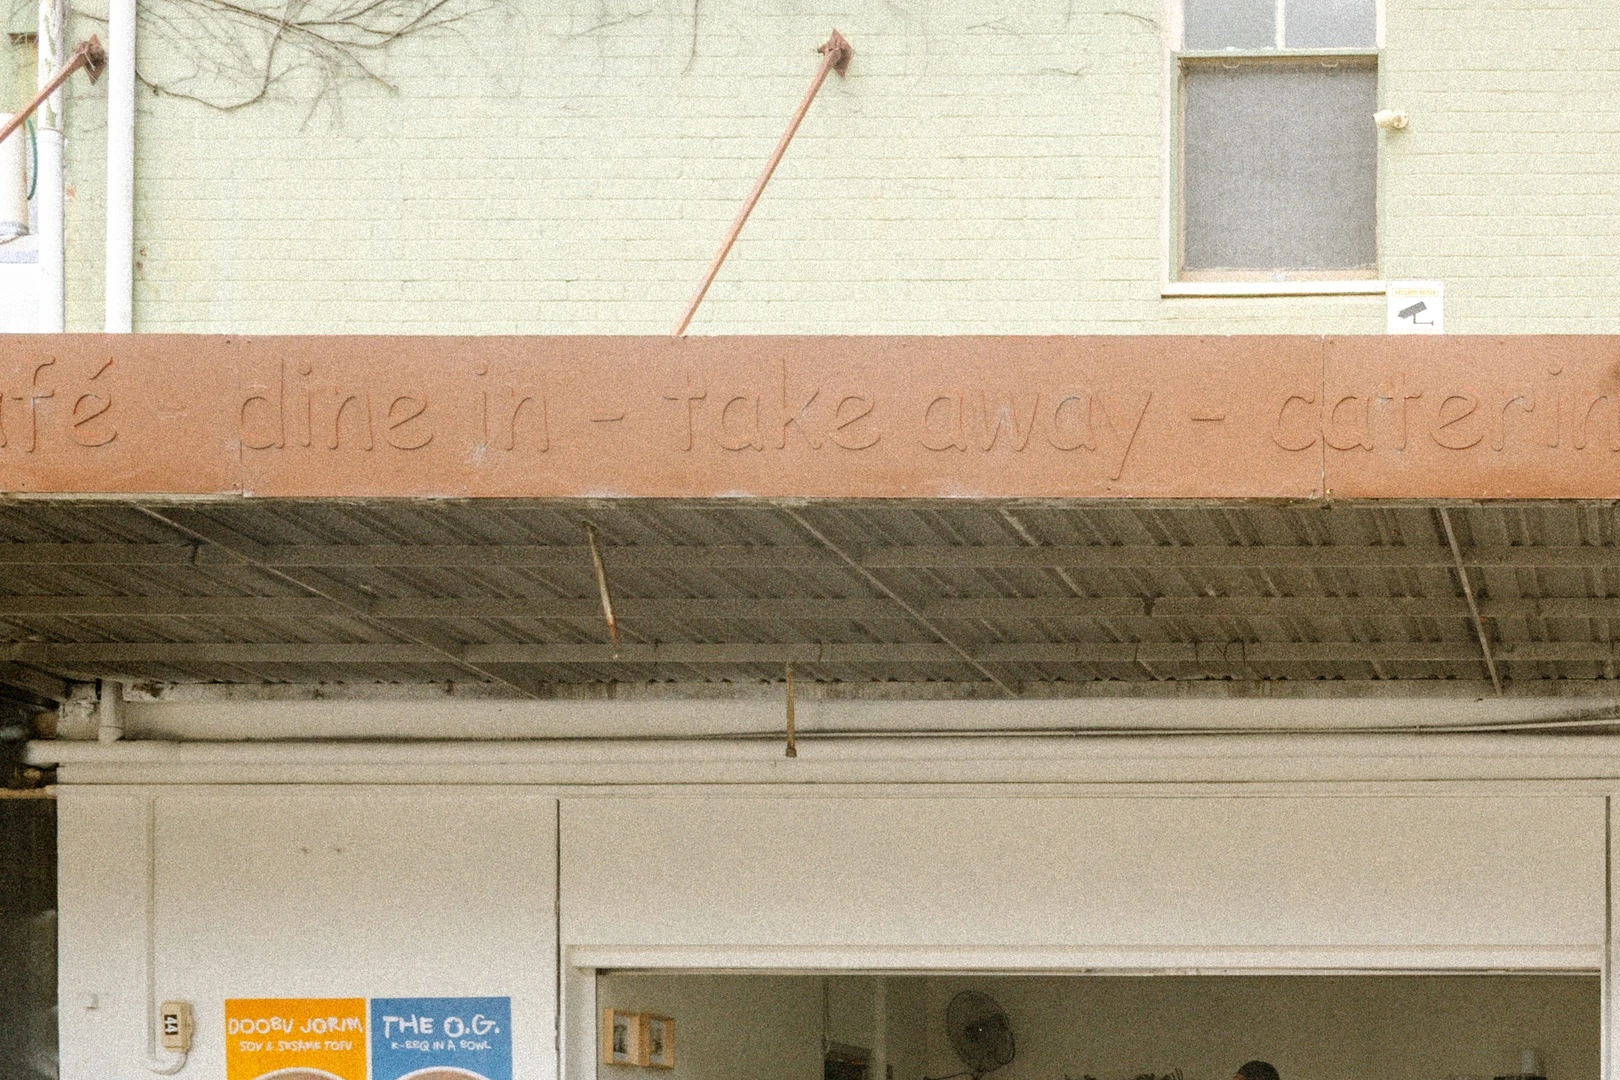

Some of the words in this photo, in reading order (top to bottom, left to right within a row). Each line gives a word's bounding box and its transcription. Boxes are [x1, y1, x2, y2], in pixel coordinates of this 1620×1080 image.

[0, 356, 119, 453] fé
[238, 356, 435, 452] dine
[472, 357, 551, 453] in
[662, 354, 882, 452] take
[917, 387, 1153, 482] away
[300, 1016, 364, 1034] JORIM
[382, 1014, 435, 1039] THE
[443, 1013, 501, 1038] O.G.
[277, 1040, 322, 1052] SESAME
[324, 1041, 353, 1051] TOFU
[391, 1040, 430, 1052] K-BBQ
[433, 1041, 444, 1050] IN
[447, 1040, 456, 1051] A
[460, 1040, 492, 1051] BOWL
